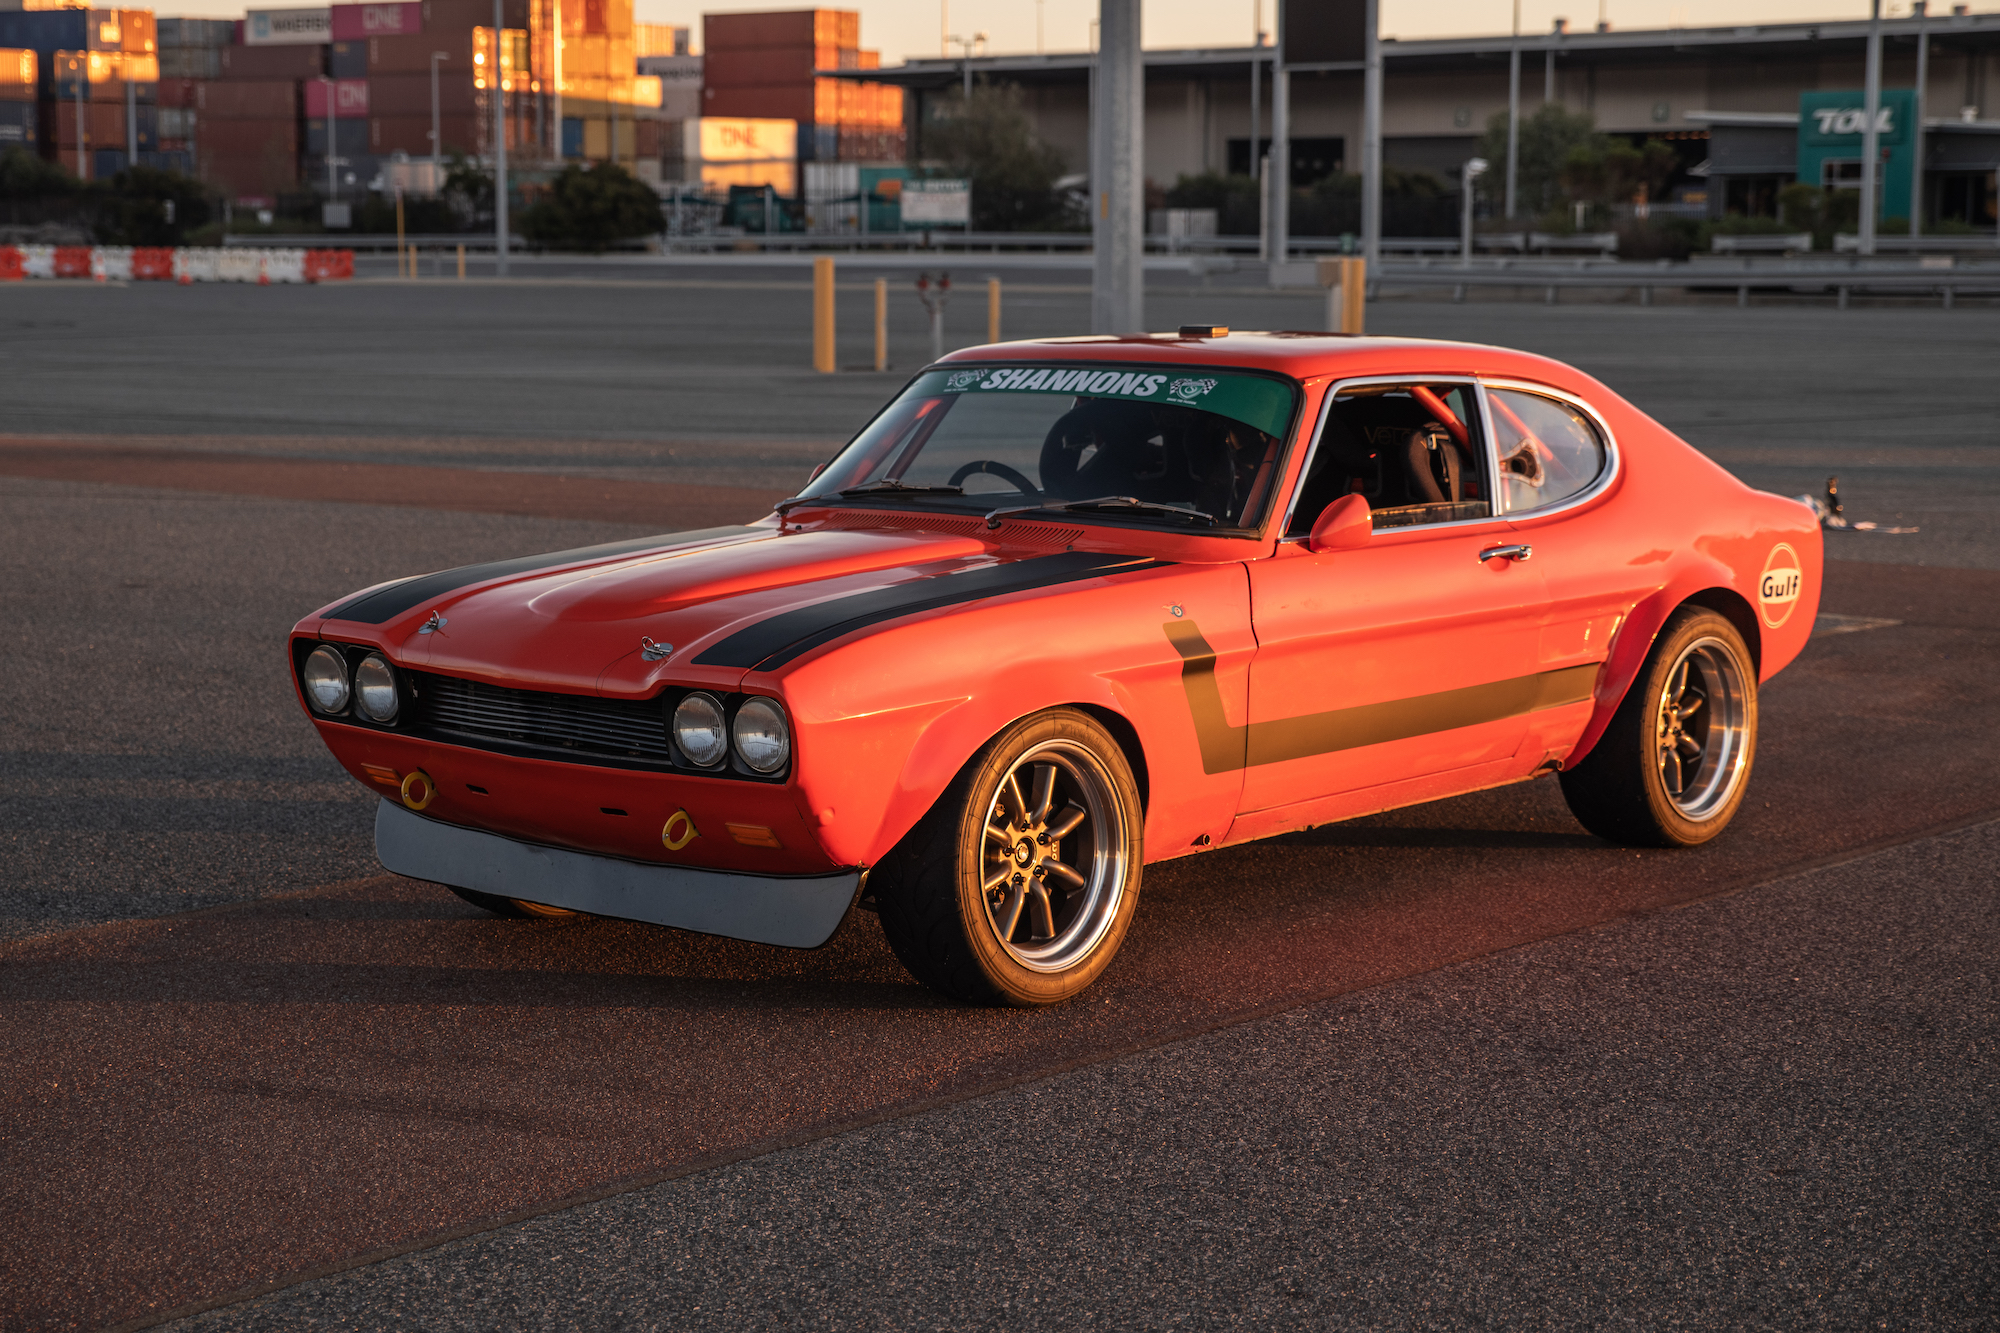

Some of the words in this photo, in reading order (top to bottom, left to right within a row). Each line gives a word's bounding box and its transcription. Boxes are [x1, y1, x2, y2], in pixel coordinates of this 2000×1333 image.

[338, 85, 367, 108] ON
[979, 368, 1168, 396] SHANNONS
[1762, 575, 1798, 598] Gulf
